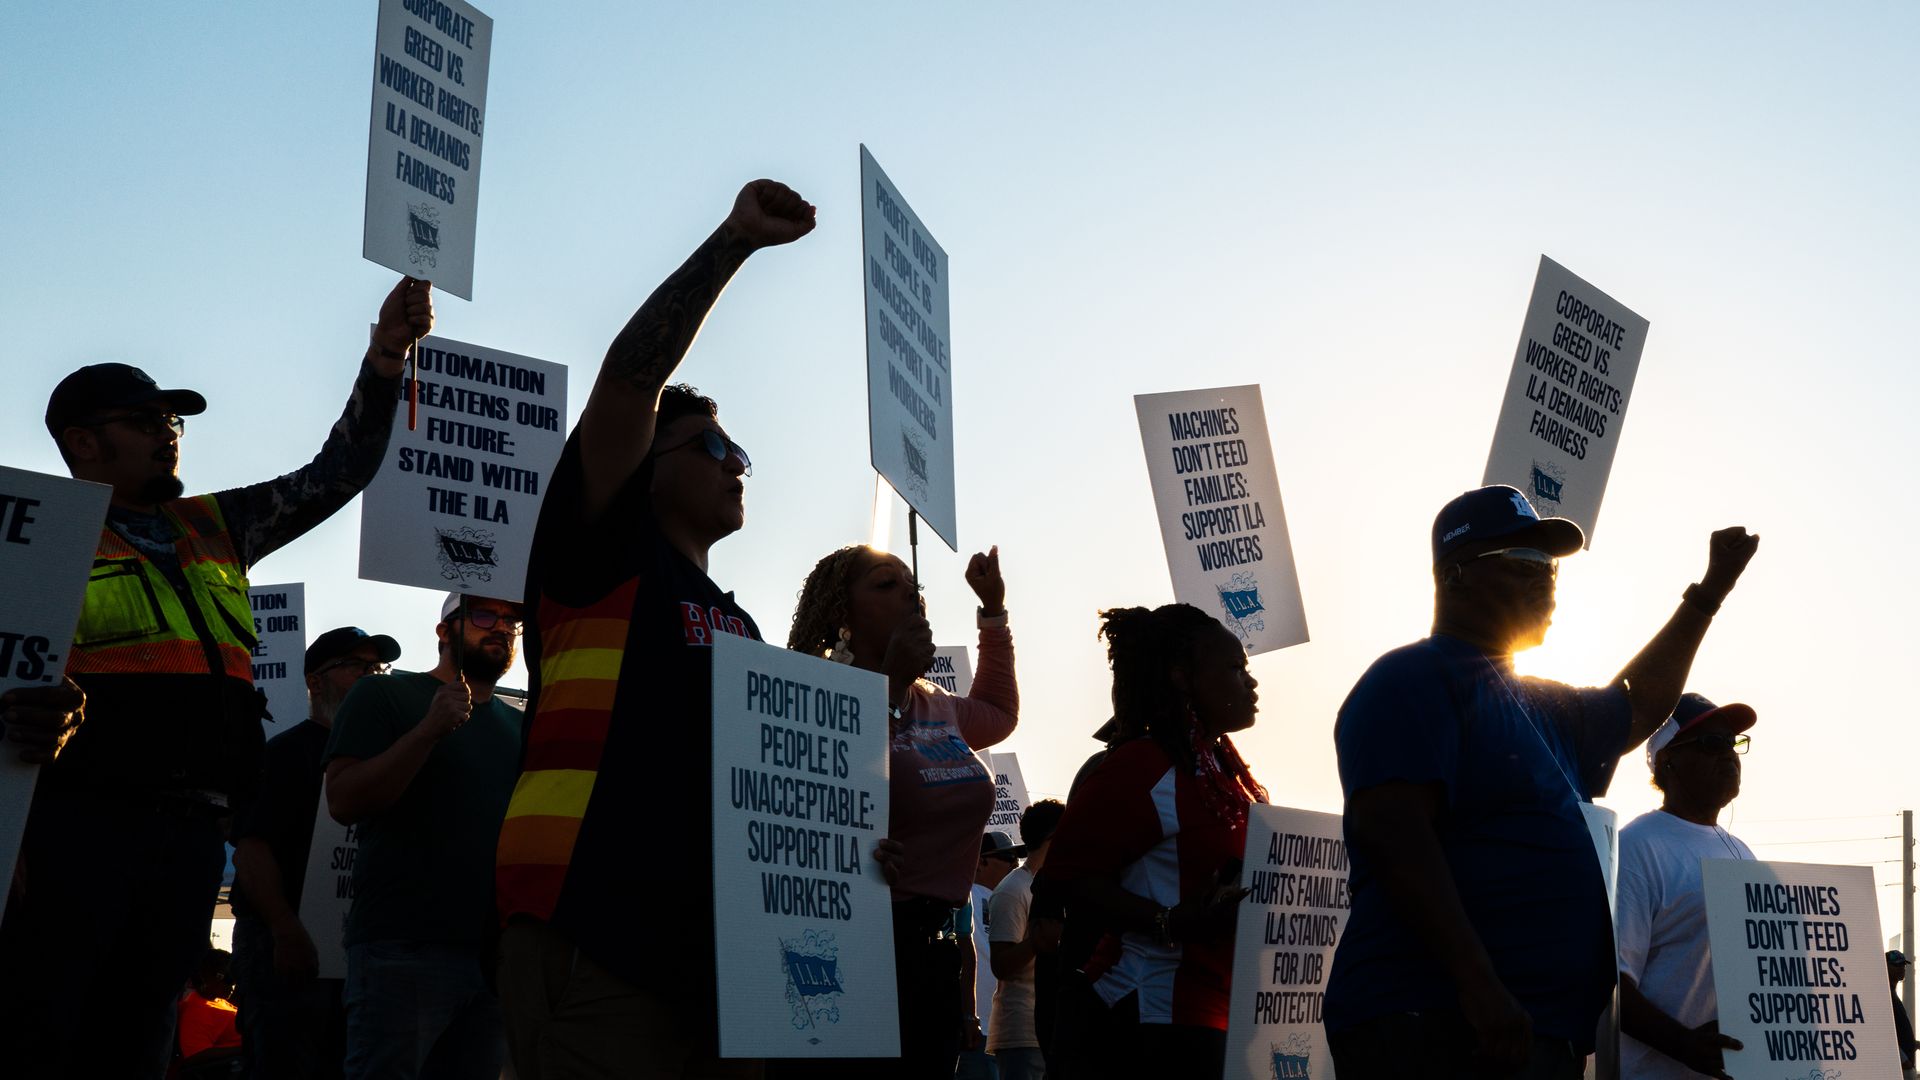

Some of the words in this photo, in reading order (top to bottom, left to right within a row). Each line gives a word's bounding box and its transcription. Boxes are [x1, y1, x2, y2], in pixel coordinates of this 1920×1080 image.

[404, 25, 442, 72] GREED
[447, 50, 465, 87] VS.
[380, 53, 434, 109] WORKER
[437, 87, 482, 137] RIGHTS:
[386, 102, 406, 140] ILA
[410, 114, 470, 171] DEMANDS
[396, 151, 455, 205] FAIRNESS
[876, 178, 909, 246] PROFIT
[912, 228, 937, 283] OVER
[884, 231, 920, 301] PEOPLE
[922, 280, 932, 314] IS
[870, 254, 947, 372] UNACCEPTABLE:
[1556, 290, 1625, 351] CORPORATE
[879, 308, 923, 386] SUPPORT
[926, 366, 942, 407] ILA
[1552, 322, 1592, 363] GREED
[1593, 350, 1610, 377] VS.
[888, 360, 936, 441] WORKERS
[1525, 338, 1577, 388] WORKER
[1578, 370, 1622, 415] RIGHTS:
[399, 377, 509, 422] HREATENS
[517, 402, 558, 432] OUR
[1169, 407, 1239, 441] MACHINES
[1525, 373, 1545, 406] ILA
[1548, 386, 1607, 438] DEMANDS
[427, 417, 515, 457] FUTURE:
[1172, 445, 1213, 474] DON'T
[1214, 439, 1248, 468] FEED
[1529, 409, 1588, 461] FAIRNESS
[399, 447, 473, 483] STAND
[481, 462, 538, 495] WITH
[1184, 473, 1250, 506] FAMILIES:
[427, 487, 467, 517] THE
[474, 495, 509, 525] ILA
[1182, 505, 1240, 541] SUPPORT
[1242, 502, 1265, 531] ILA
[1197, 535, 1263, 571] WORKERS
[1443, 523, 1471, 543] MEMBER
[267, 615, 298, 632] OUR
[747, 670, 812, 722] PROFIT
[815, 687, 861, 735] OVER
[761, 723, 829, 774] PEOPLE
[833, 739, 848, 779] IS
[731, 767, 875, 831] UNACCEPTABLE:
[986, 812, 1023, 826] ECURITY
[748, 820, 832, 870] SUPPORT
[835, 835, 861, 875] ILA
[1267, 832, 1348, 871] AUTOMATION
[761, 872, 851, 921] WORKERS
[1251, 870, 1296, 906] HURTS
[1744, 883, 1841, 916] MACHINES
[1265, 912, 1285, 945] ILA
[1288, 914, 1337, 947] STANDS
[1745, 919, 1798, 950] DON'T
[1803, 922, 1849, 952] FEED
[1272, 952, 1298, 985] FOR
[1300, 953, 1323, 985] JOB
[1758, 956, 1846, 988] FAMILIES:
[1254, 992, 1323, 1025] PROTECTIO
[1748, 993, 1830, 1024] SUPPORT
[1832, 994, 1865, 1024] ILA
[1765, 1030, 1857, 1061] WORKERS
